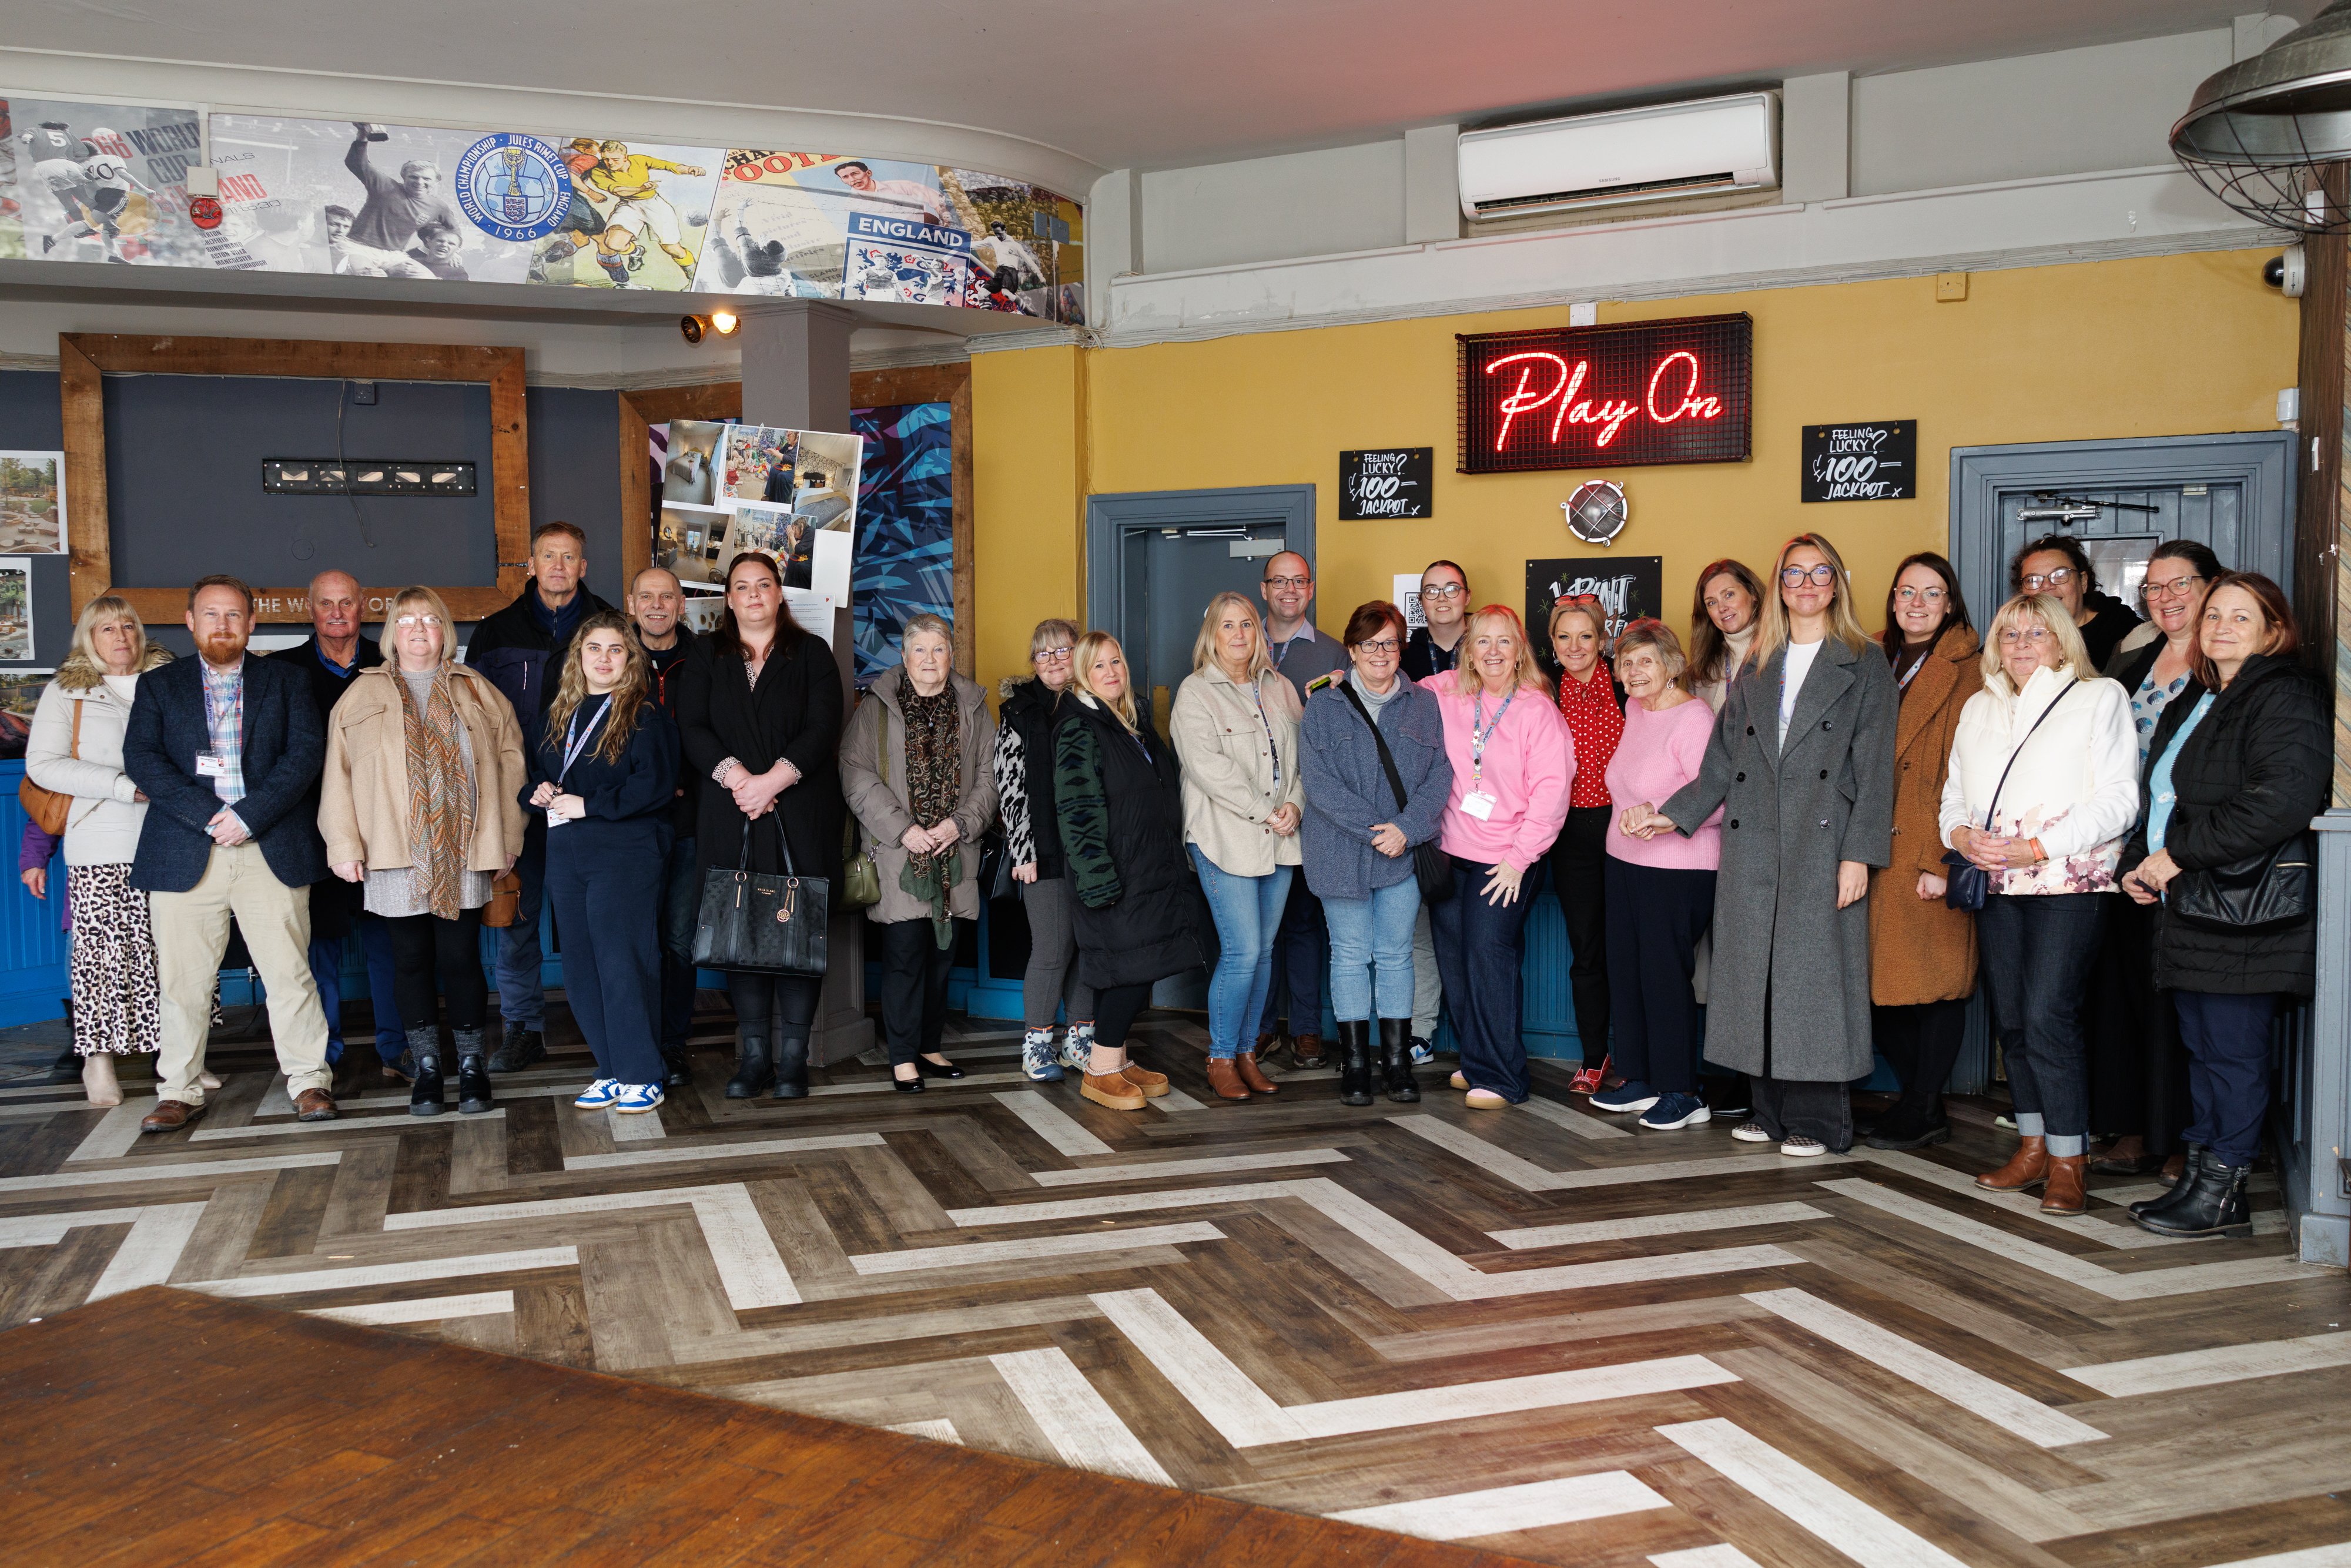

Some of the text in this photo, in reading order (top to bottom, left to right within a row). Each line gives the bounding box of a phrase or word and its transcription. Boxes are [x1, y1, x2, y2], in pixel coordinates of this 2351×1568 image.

[47, 131, 67, 147] 5
[125, 122, 200, 156] WORLD
[458, 134, 571, 227] WORLD CHAMPIONSHIP JULES RIMET CUP ENGLAND
[495, 226, 537, 240] 1966
[858, 217, 963, 247] ENGLAND
[206, 242, 243, 253] SUNDERLAND
[210, 248, 247, 260] ASTON VILLA
[215, 254, 253, 266] MANCHESTER
[1485, 351, 1723, 451] Play On
[1832, 427, 1873, 440] FEELING
[1364, 453, 1395, 463] FEELING
[1822, 481, 1890, 500] JACKPOT
[1357, 498, 1409, 516] JACKPOT
[574, 732, 589, 753] GrowingPlaces
